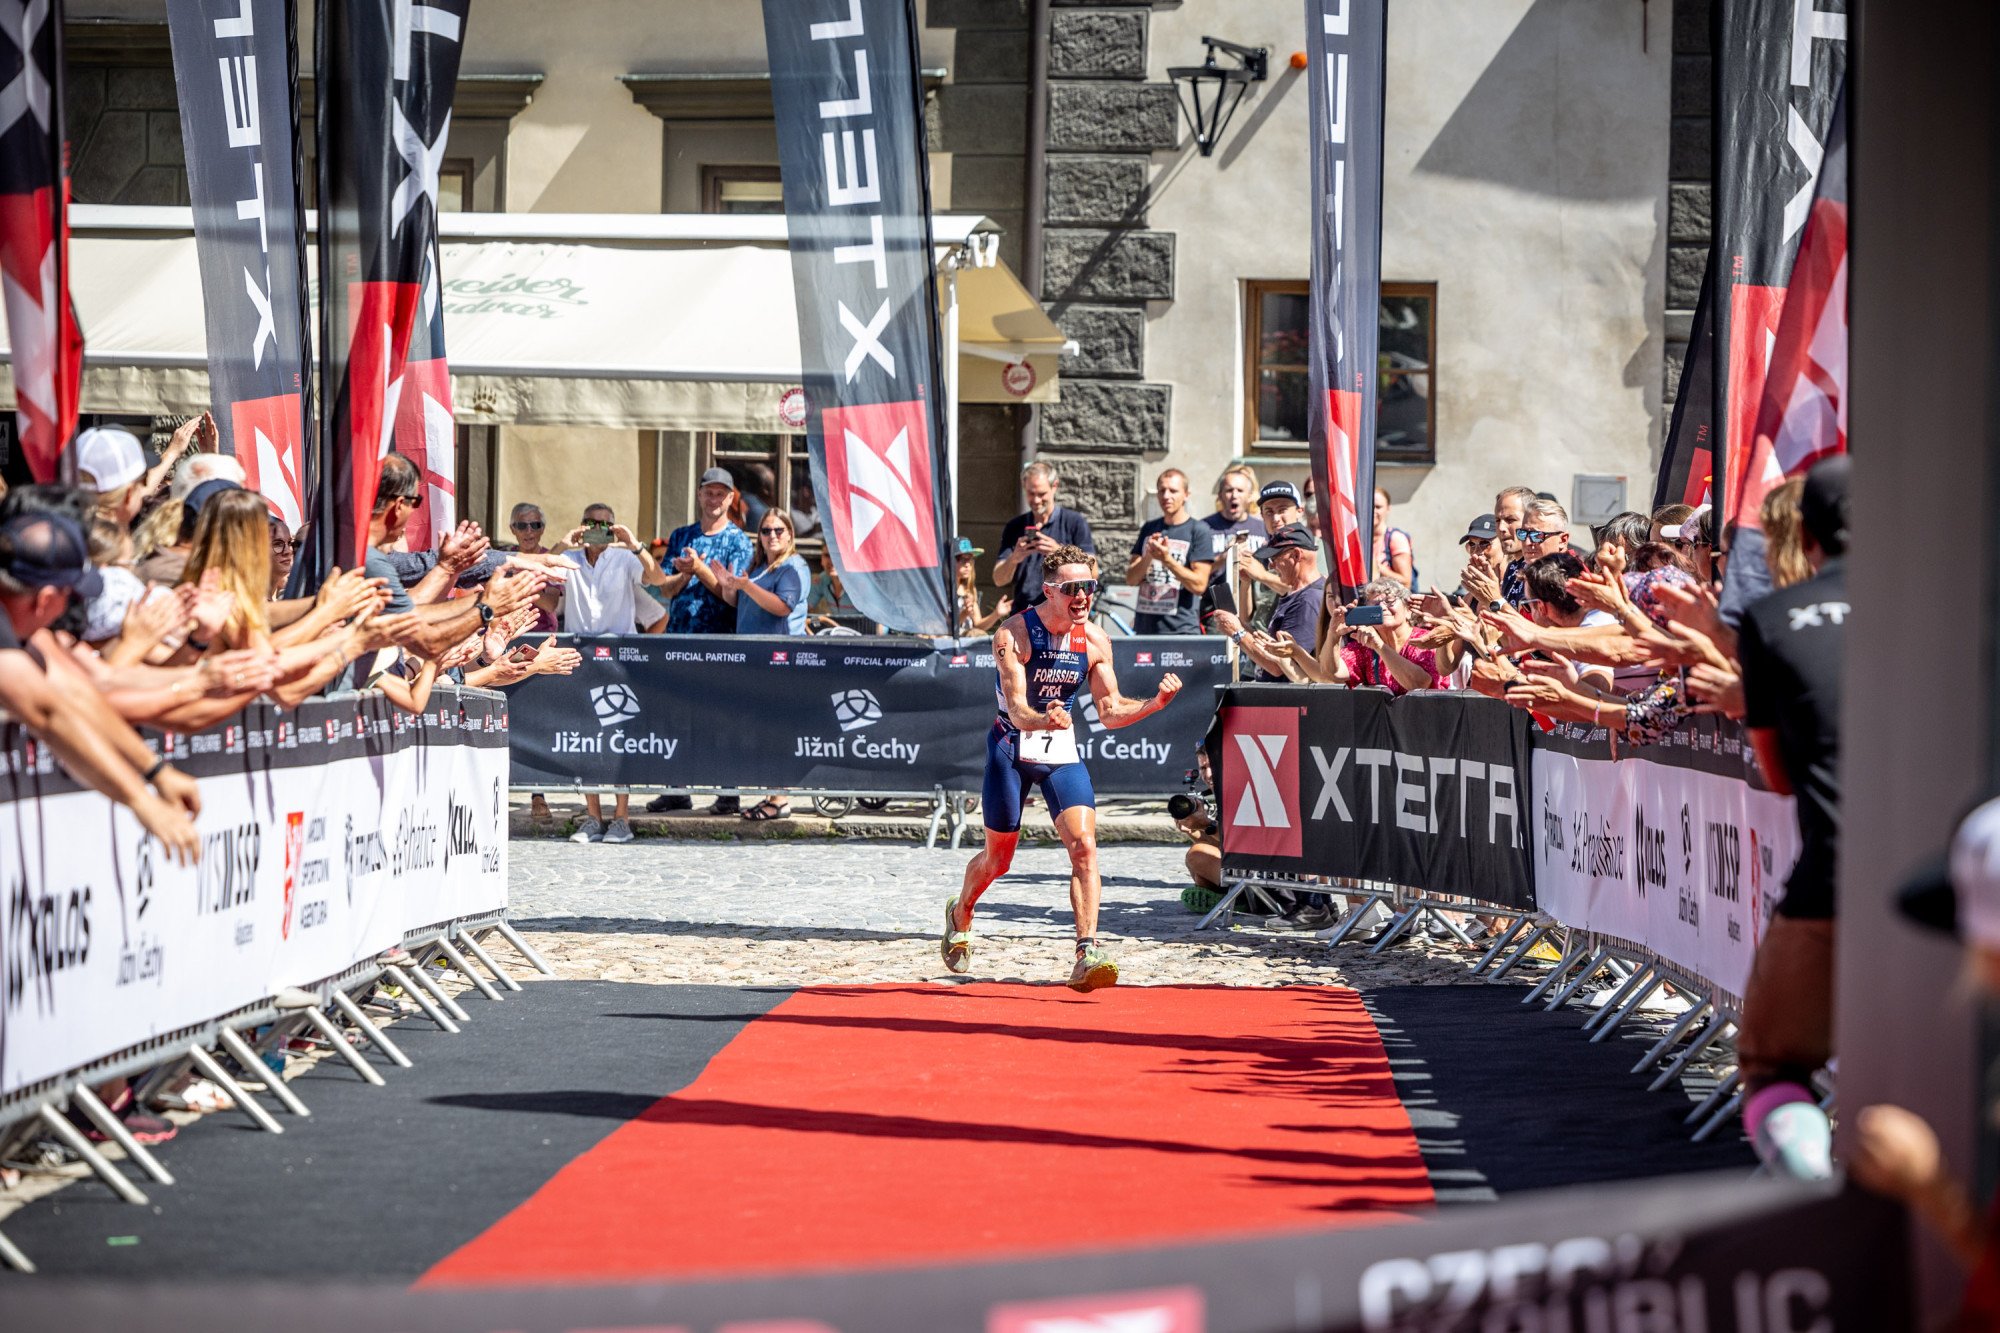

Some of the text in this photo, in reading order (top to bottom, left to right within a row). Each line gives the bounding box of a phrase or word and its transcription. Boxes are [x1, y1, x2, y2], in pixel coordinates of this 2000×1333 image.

[618, 654, 650, 662] REPUBLIC
[665, 651, 747, 663] OFFICIAL PARTNER
[843, 656, 927, 667] OFFICIAL PARTNER
[1033, 668, 1080, 684] FORISSIER
[1038, 685, 1063, 697] FRA
[551, 729, 679, 760] Jižní Čechy
[794, 734, 921, 765] Jižní Čechy
[1040, 736, 1053, 754] 7
[1100, 734, 1172, 765] Čechy
[1309, 745, 1520, 850] XTERRA
